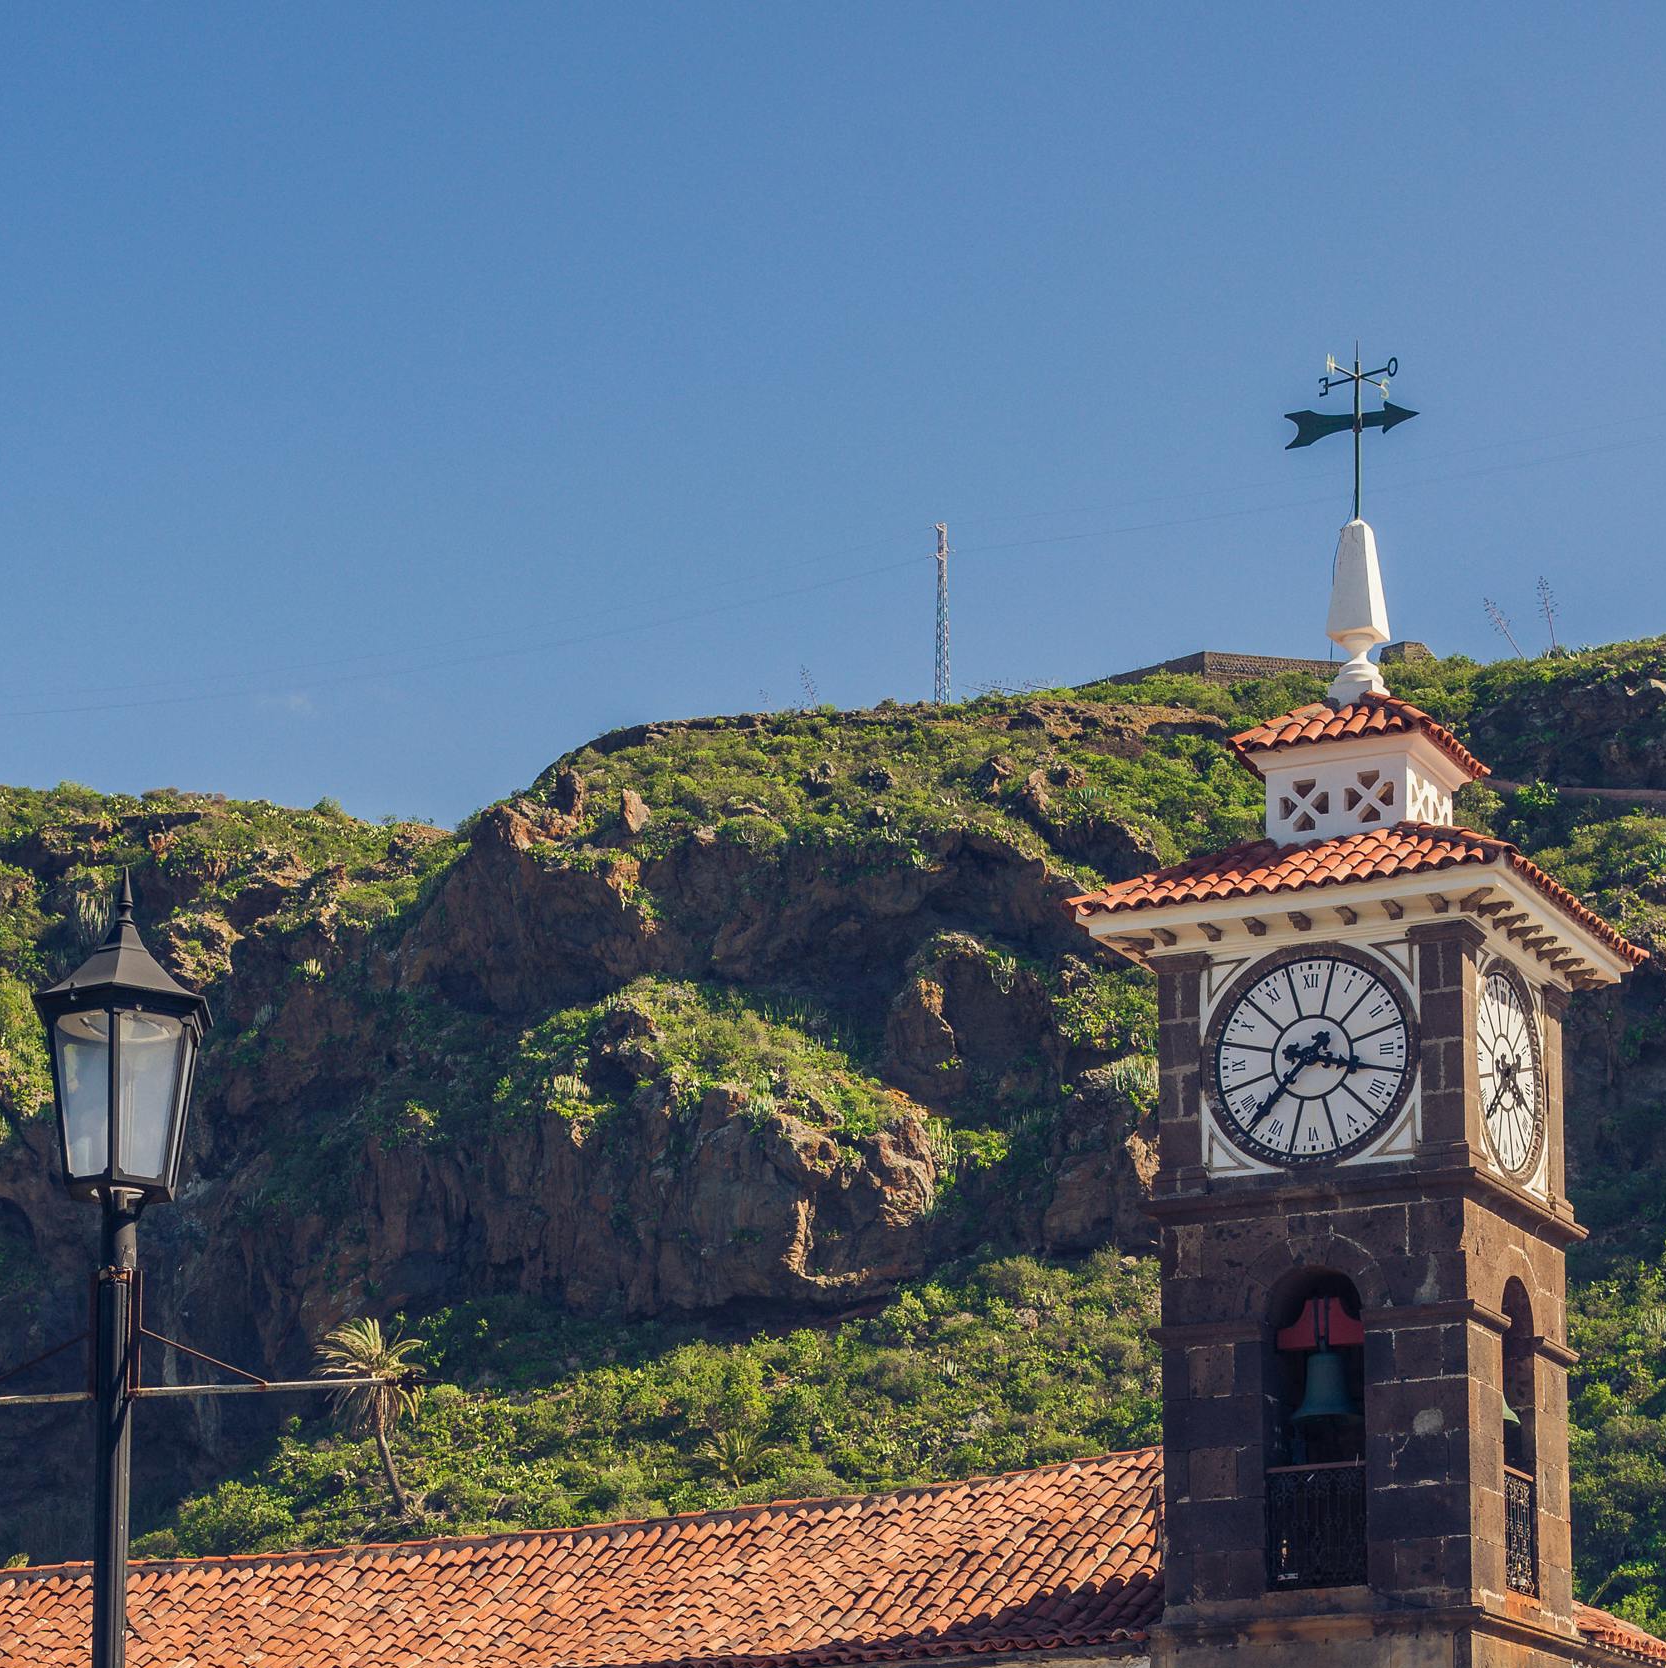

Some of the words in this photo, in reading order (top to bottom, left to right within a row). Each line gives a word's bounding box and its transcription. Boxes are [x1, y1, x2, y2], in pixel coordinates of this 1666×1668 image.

[1388, 357, 1398, 377] O
[1380, 378, 1390, 400] S
[1303, 974, 1319, 990] XII
[1344, 980, 1353, 994] I
[1266, 987, 1282, 1005] XI
[1368, 1004, 1384, 1018] II
[1241, 1021, 1255, 1032] X
[1380, 1042, 1394, 1056] III
[1232, 1060, 1246, 1072] IX
[1368, 1078, 1386, 1099] IIII
[1240, 1094, 1257, 1114] VIII
[1268, 1118, 1284, 1137] VII
[1346, 1112, 1358, 1128] V
[1308, 1126, 1320, 1142] VI
